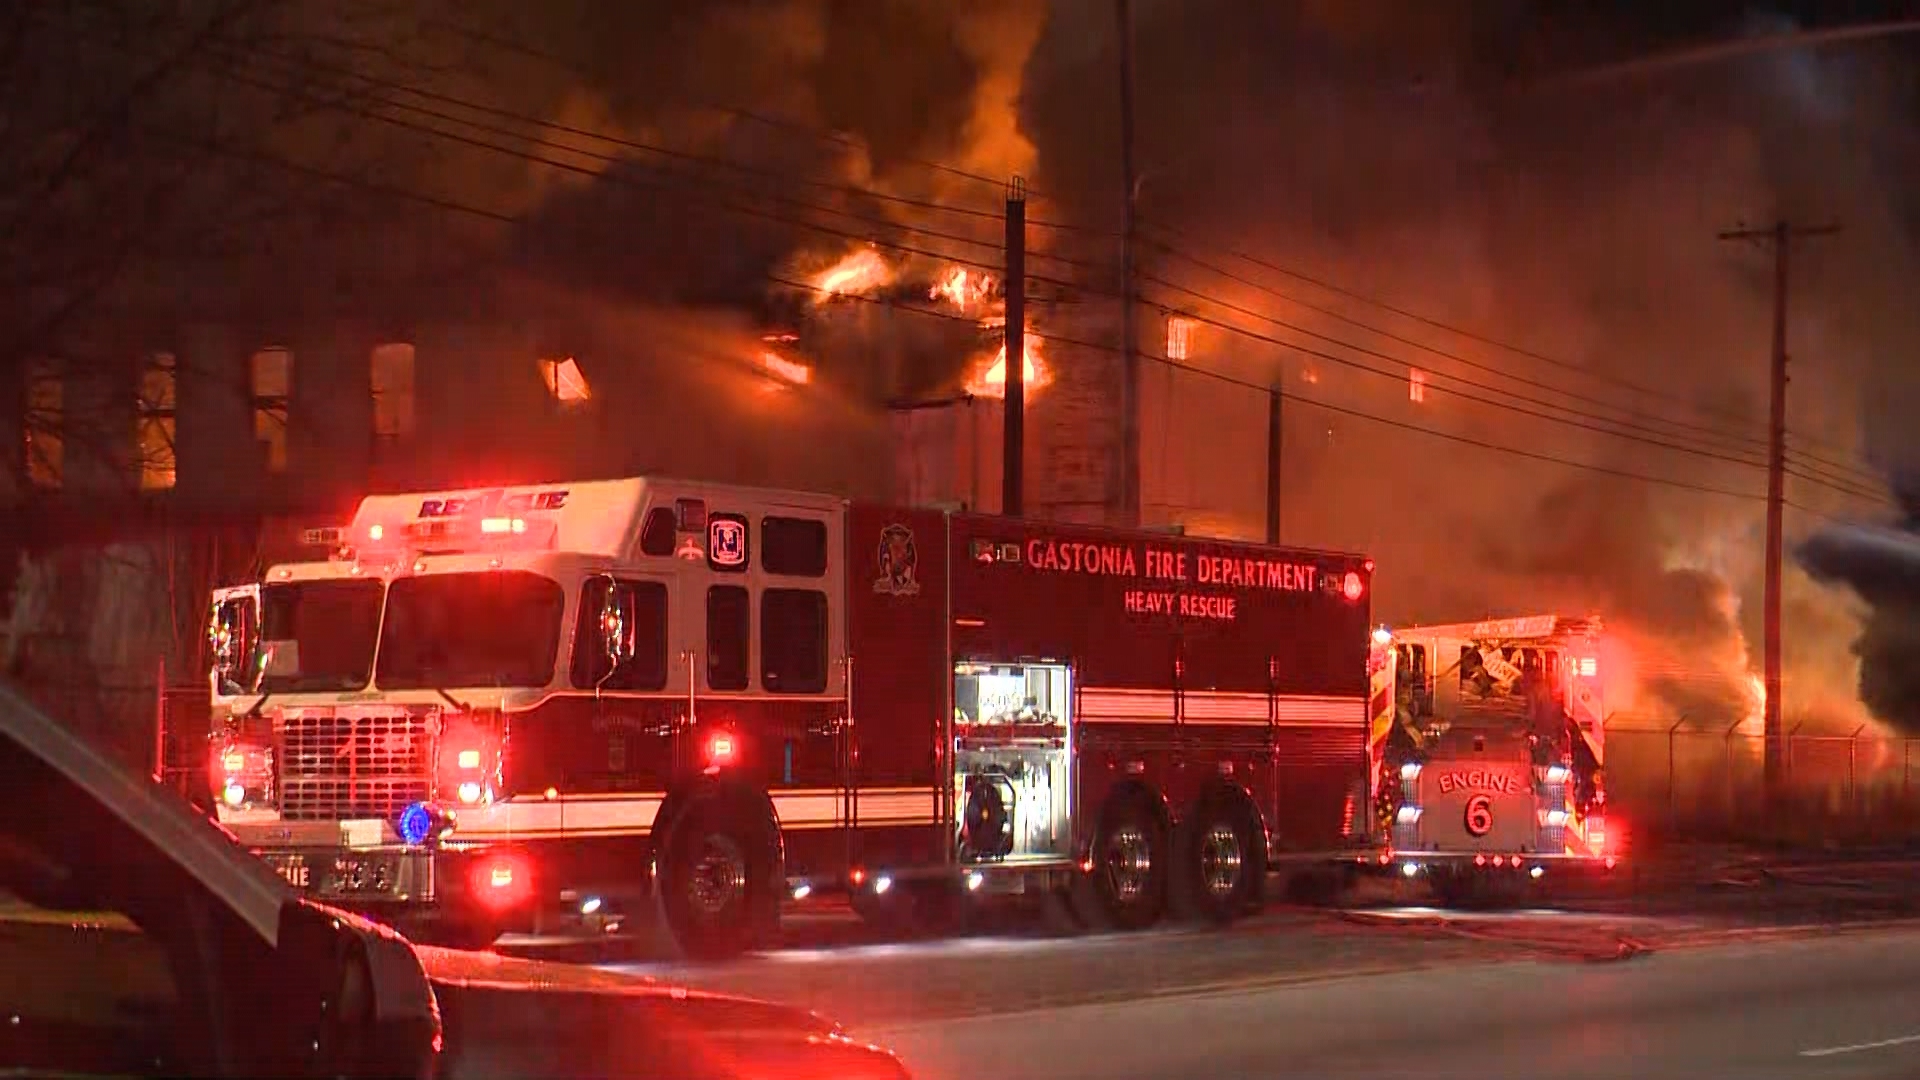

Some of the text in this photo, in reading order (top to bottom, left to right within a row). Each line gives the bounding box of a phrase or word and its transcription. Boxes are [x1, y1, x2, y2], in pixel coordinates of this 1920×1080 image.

[1027, 539, 1317, 592] GASTONIA FIRE DEPARTMENT
[1124, 590, 1237, 619] HEAVY RESCUE
[1439, 771, 1521, 794] ENGINE
[1464, 794, 1494, 837] 6
